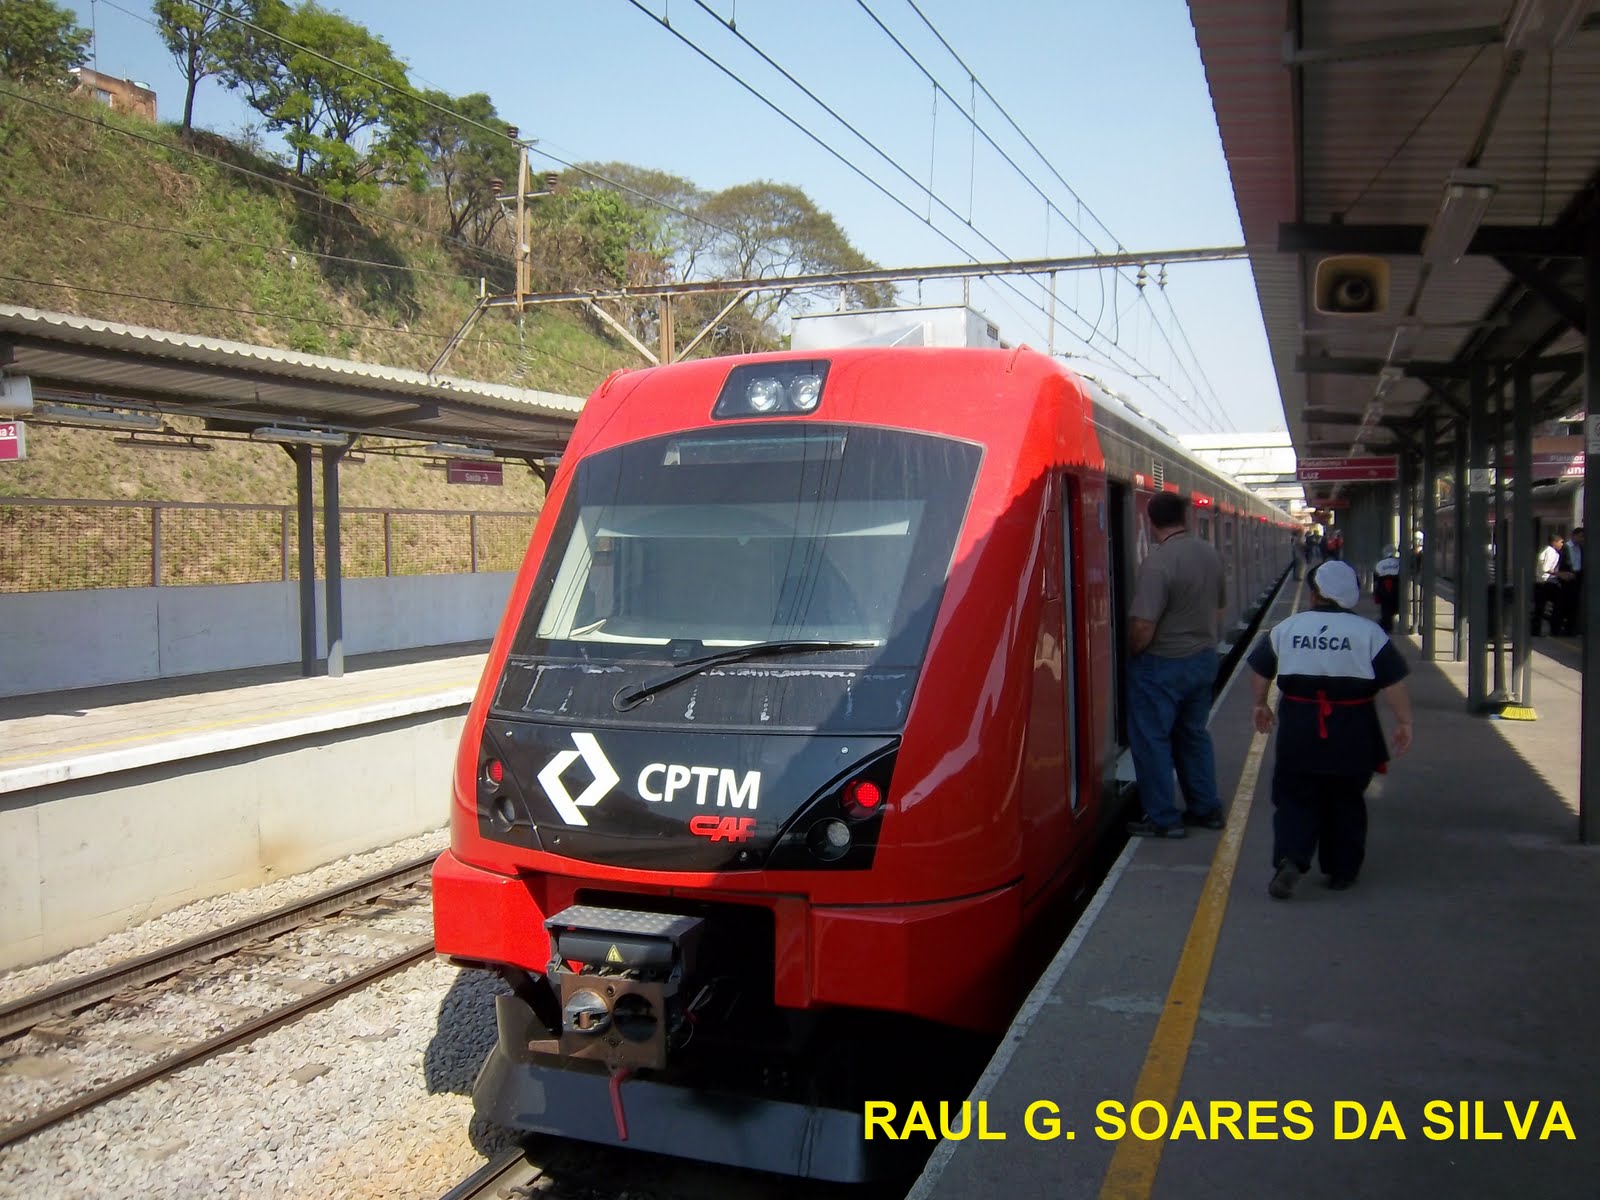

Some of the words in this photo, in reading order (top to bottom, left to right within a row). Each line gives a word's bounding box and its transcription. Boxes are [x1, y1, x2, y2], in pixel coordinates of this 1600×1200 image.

[8, 425, 15, 436] 2
[1300, 471, 1320, 480] Luz
[637, 763, 762, 810] CPTM
[689, 815, 757, 843] CAF
